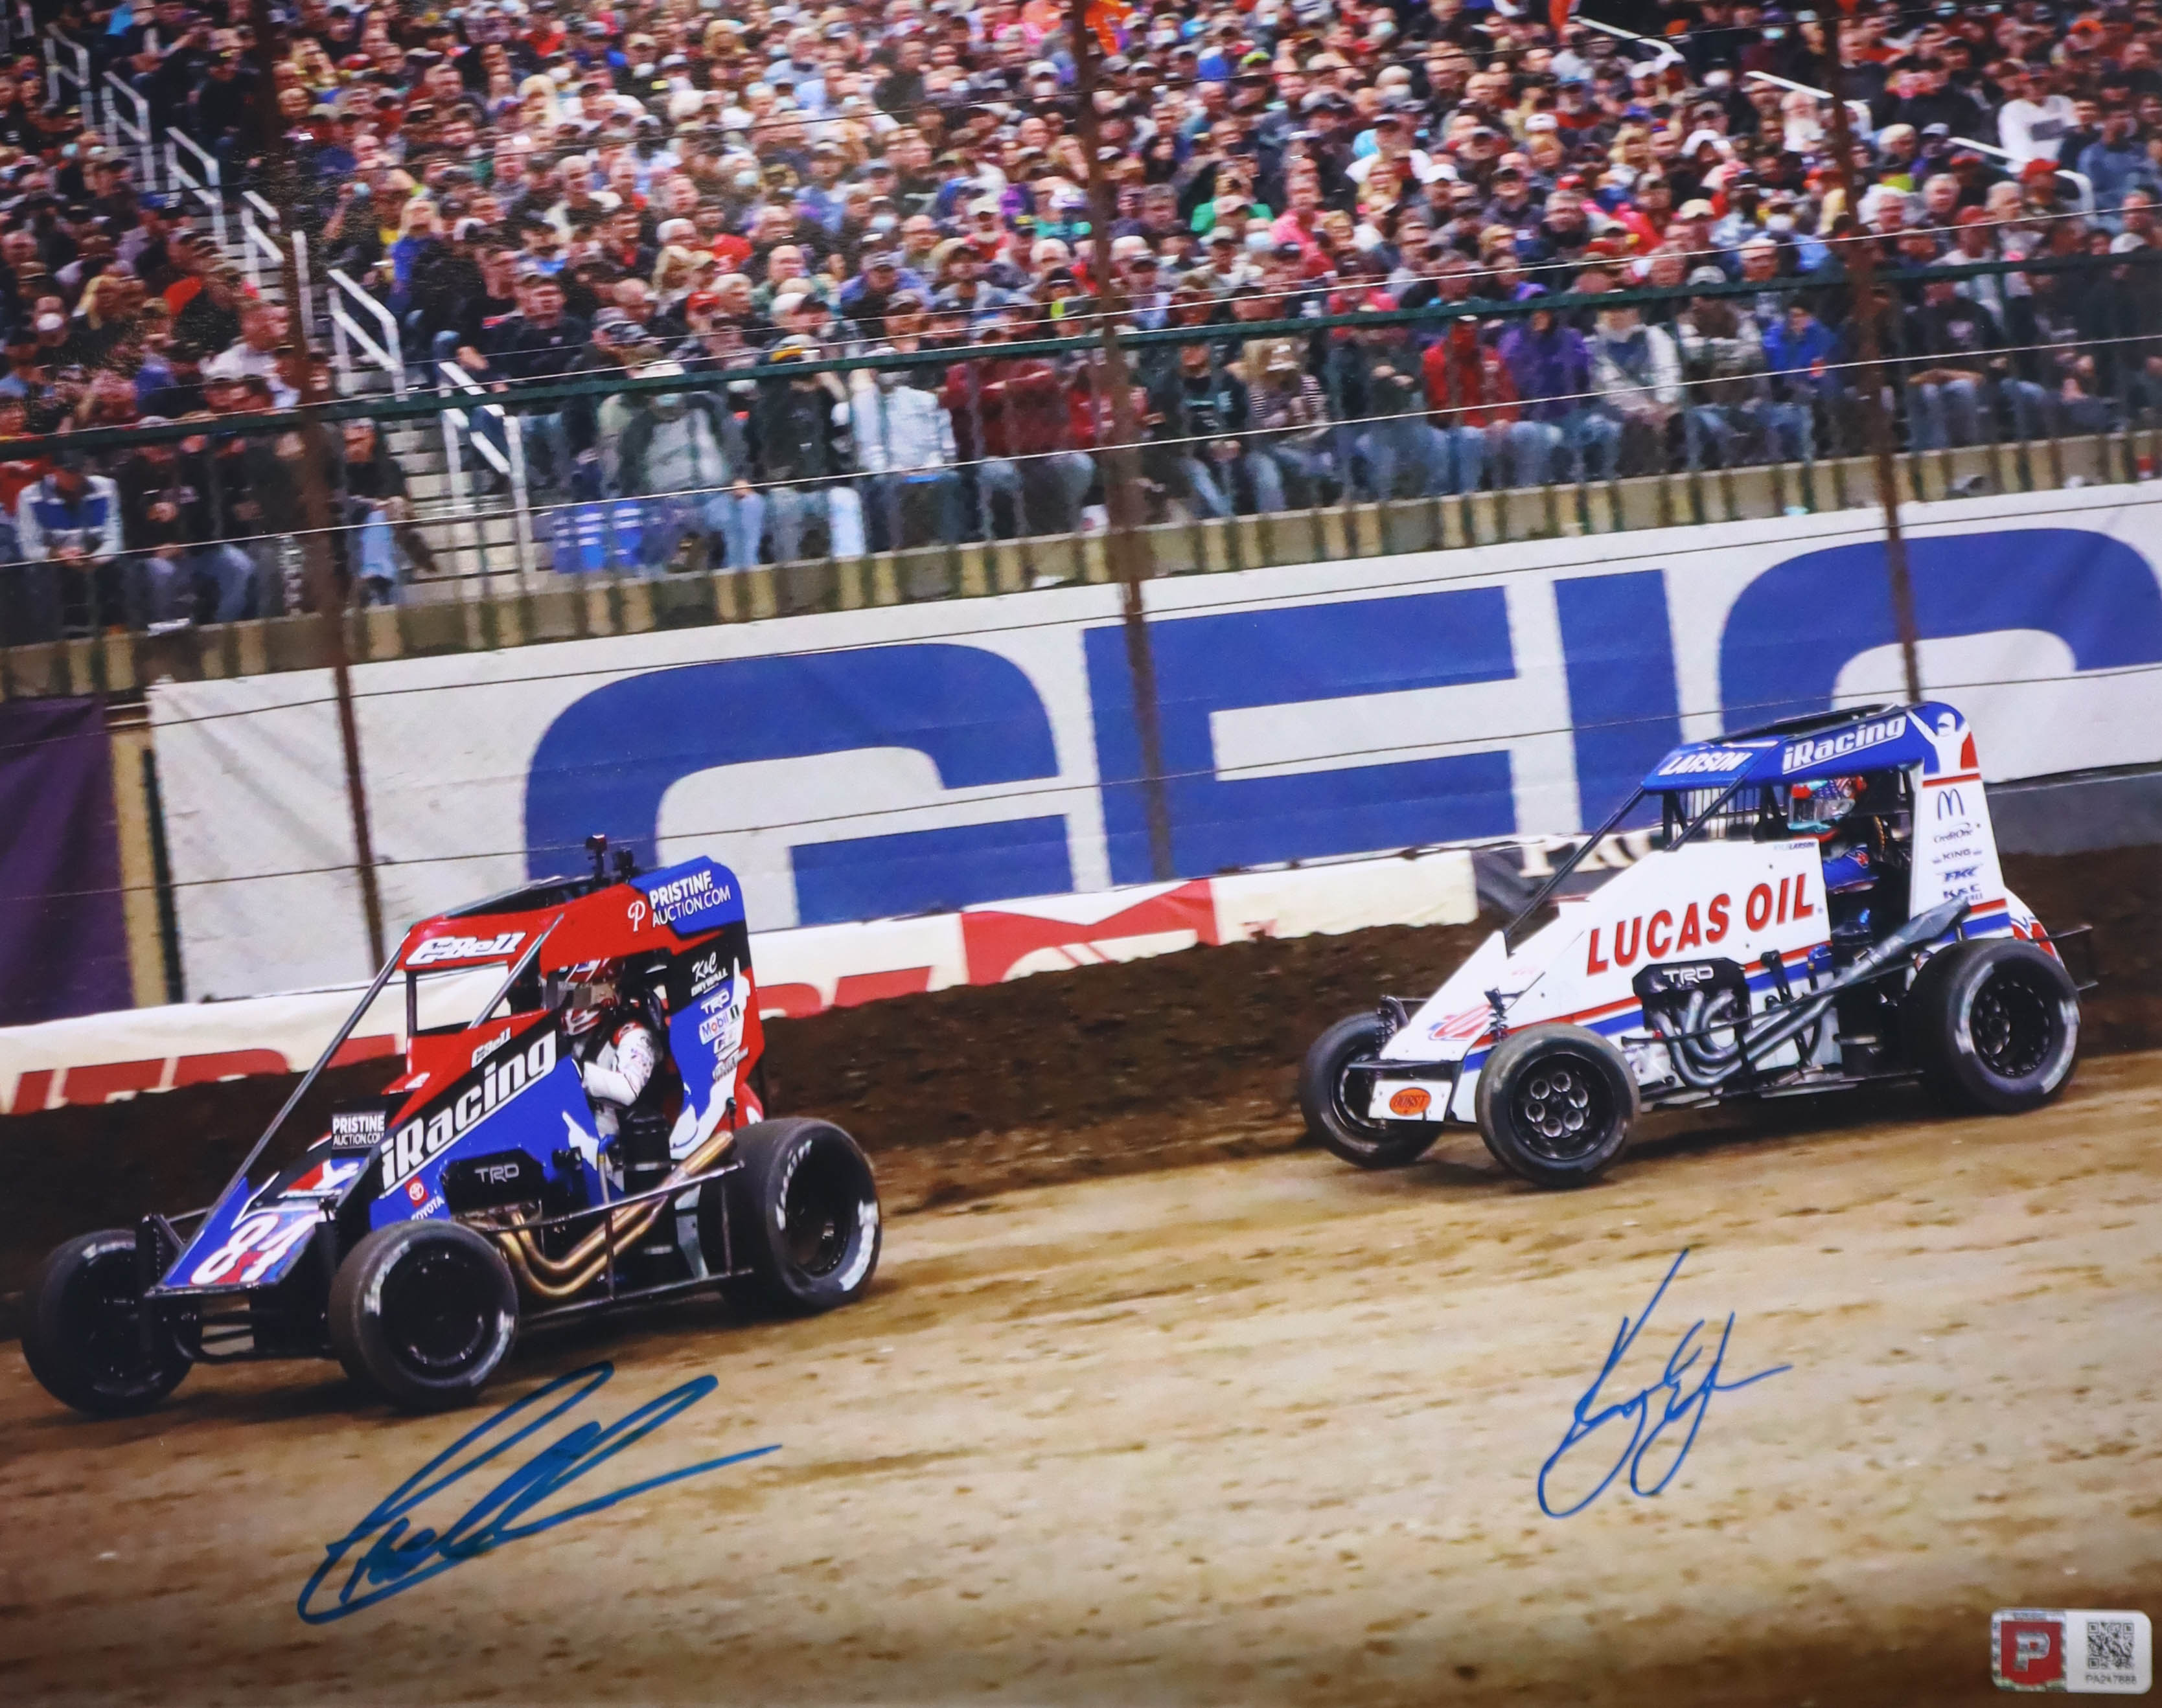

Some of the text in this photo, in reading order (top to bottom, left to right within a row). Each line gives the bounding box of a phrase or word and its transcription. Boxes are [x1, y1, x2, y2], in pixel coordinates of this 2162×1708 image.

[1782, 716, 1907, 773] iRacing
[1659, 751, 1753, 776] LARSON
[1943, 848, 1971, 860] KING
[652, 885, 731, 928] AUCTION.COM
[1587, 873, 1815, 977] LUCAS OIL
[1662, 966, 1715, 986] TRD
[700, 988, 730, 1015] TRD
[702, 1011, 729, 1036] Mobil
[380, 1029, 557, 1192] iRacing
[332, 1115, 385, 1135] PRISTINE
[474, 1163, 520, 1185] TRD
